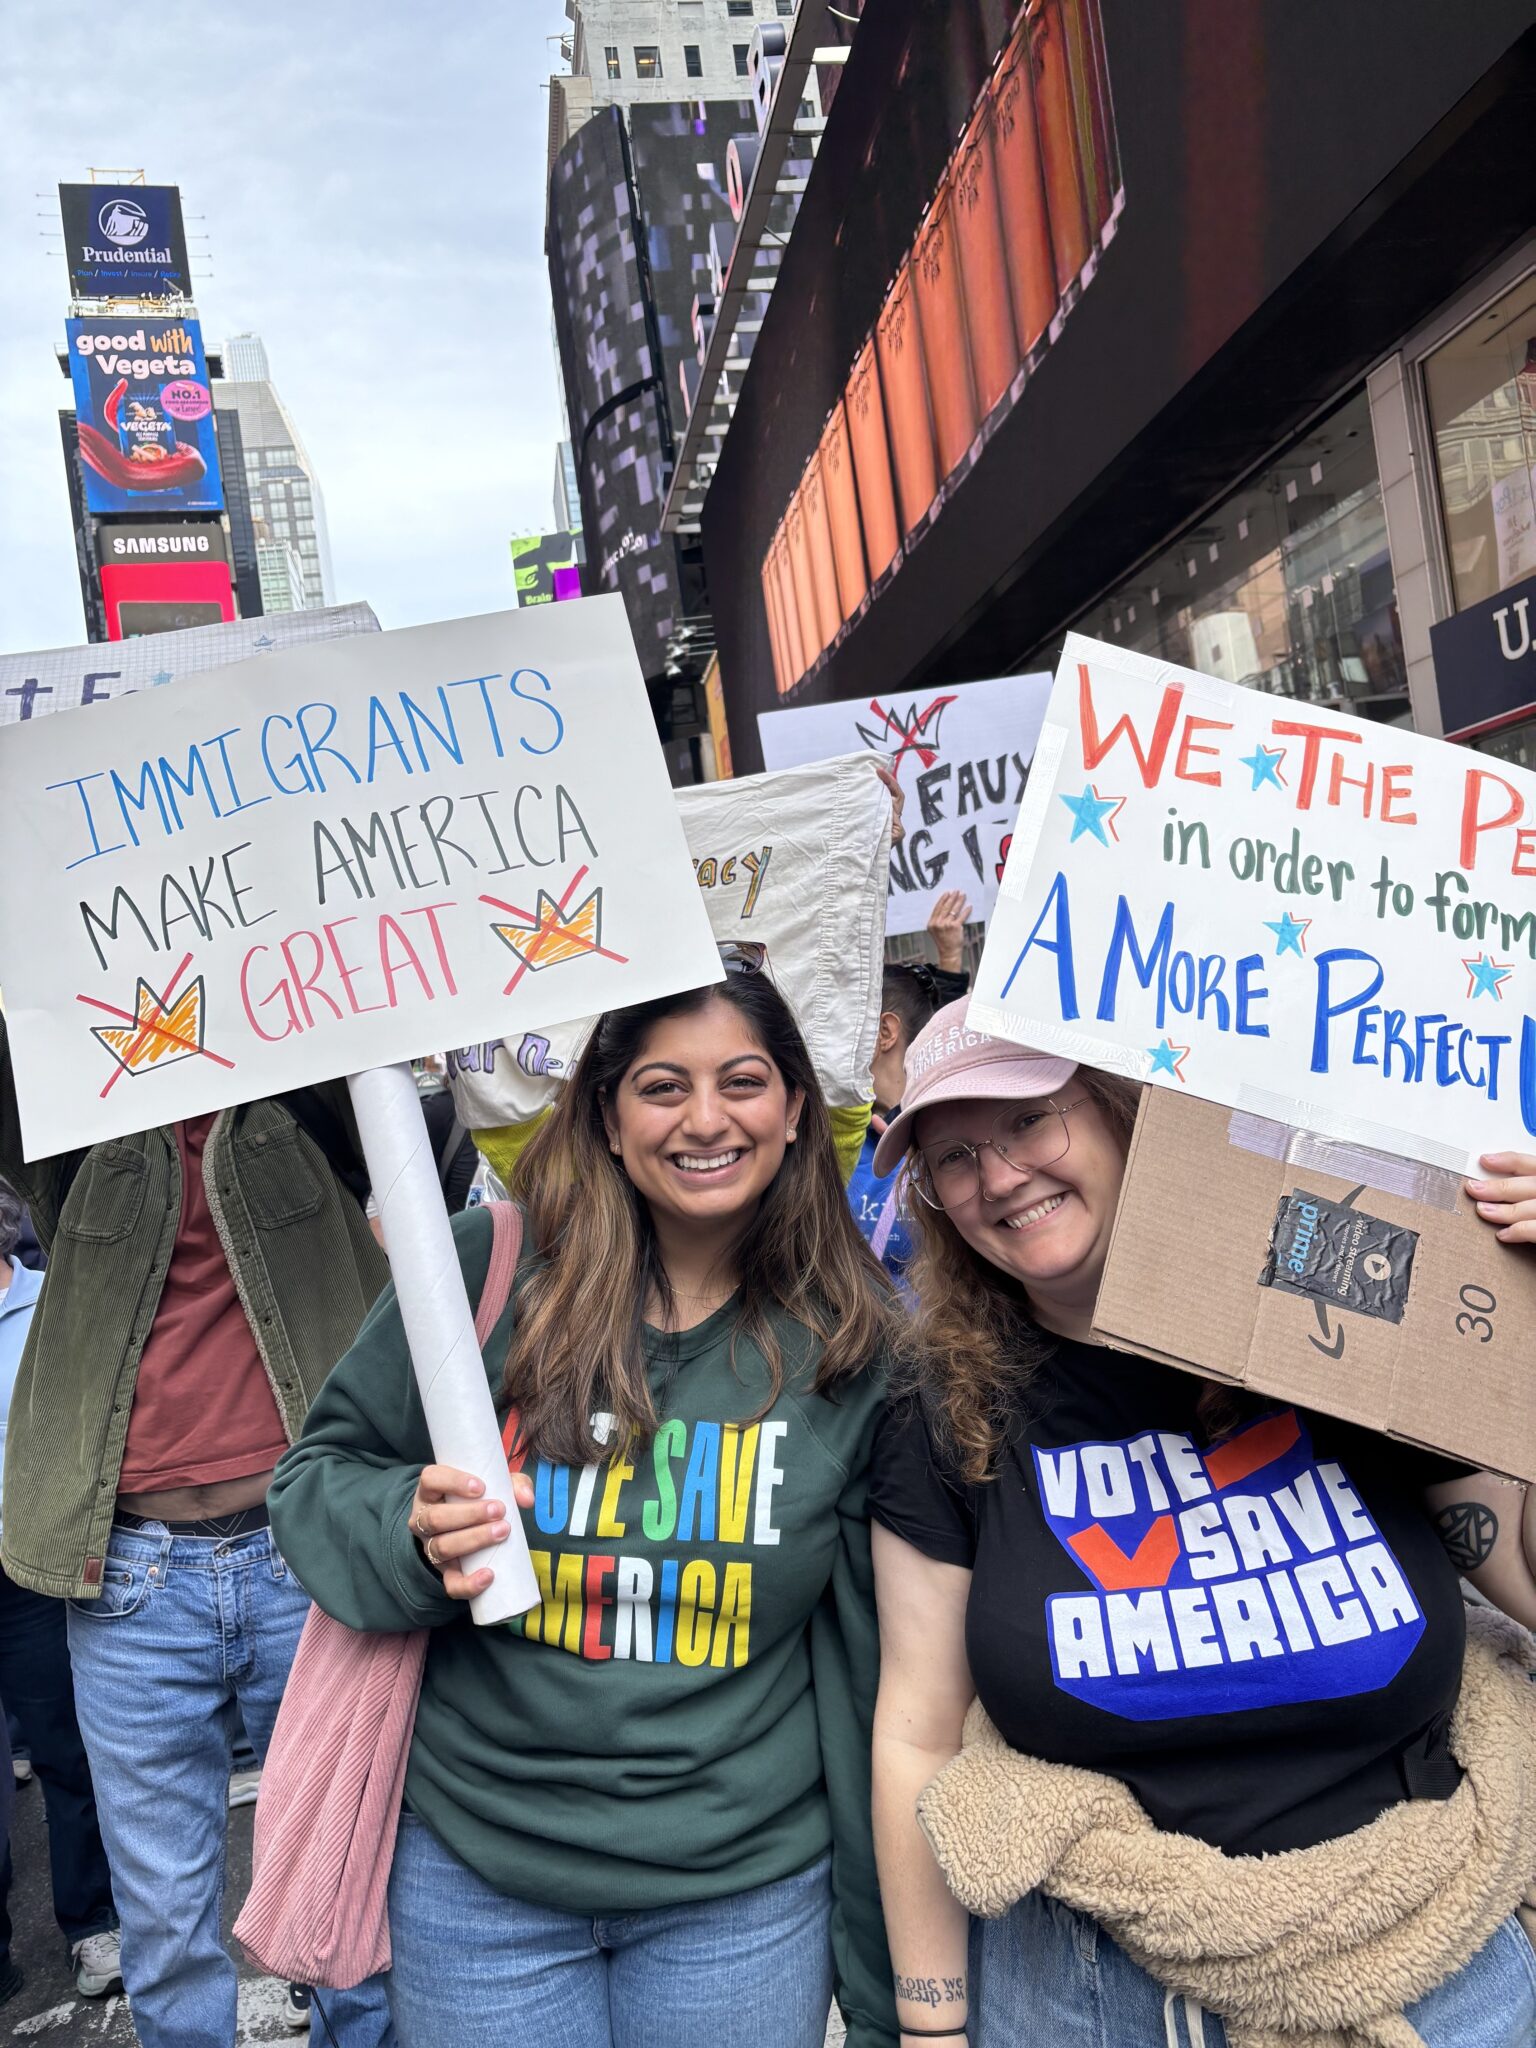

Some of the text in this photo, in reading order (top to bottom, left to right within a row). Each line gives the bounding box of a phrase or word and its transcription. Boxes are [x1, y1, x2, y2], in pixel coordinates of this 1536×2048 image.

[82, 246, 172, 263] Prudential
[76, 328, 194, 355] good with
[95, 355, 196, 380] Vegeta
[120, 421, 172, 432] VEGETA
[171, 390, 201, 400] NO.1
[113, 536, 209, 554] SAMSUNG
[46, 668, 564, 869] IMMIGRANTS
[1077, 664, 1234, 788] WE
[1272, 719, 1417, 825] THE
[80, 784, 598, 970] MAKE AMERICA
[692, 846, 773, 919] acy
[1163, 807, 1536, 960] in order to form
[239, 902, 458, 1042] GREAT
[1001, 871, 1081, 1021] A
[1097, 895, 1270, 1038] MORE
[1310, 948, 1512, 1101] PERFECT
[914, 1033, 992, 1079] AMERICA
[1288, 1202, 1318, 1273] prime
[1337, 1219, 1364, 1296] video streaming
[1341, 1223, 1351, 1244] movies
[1332, 1264, 1341, 1283] shows
[1455, 1284, 1496, 1342] 30
[642, 1419, 787, 1545] SAVE
[1037, 1433, 1212, 1518] VOTE
[1179, 1462, 1376, 1580] SAVE
[508, 1549, 752, 1668] MERICA
[1051, 1542, 1420, 1679] AMERICA
